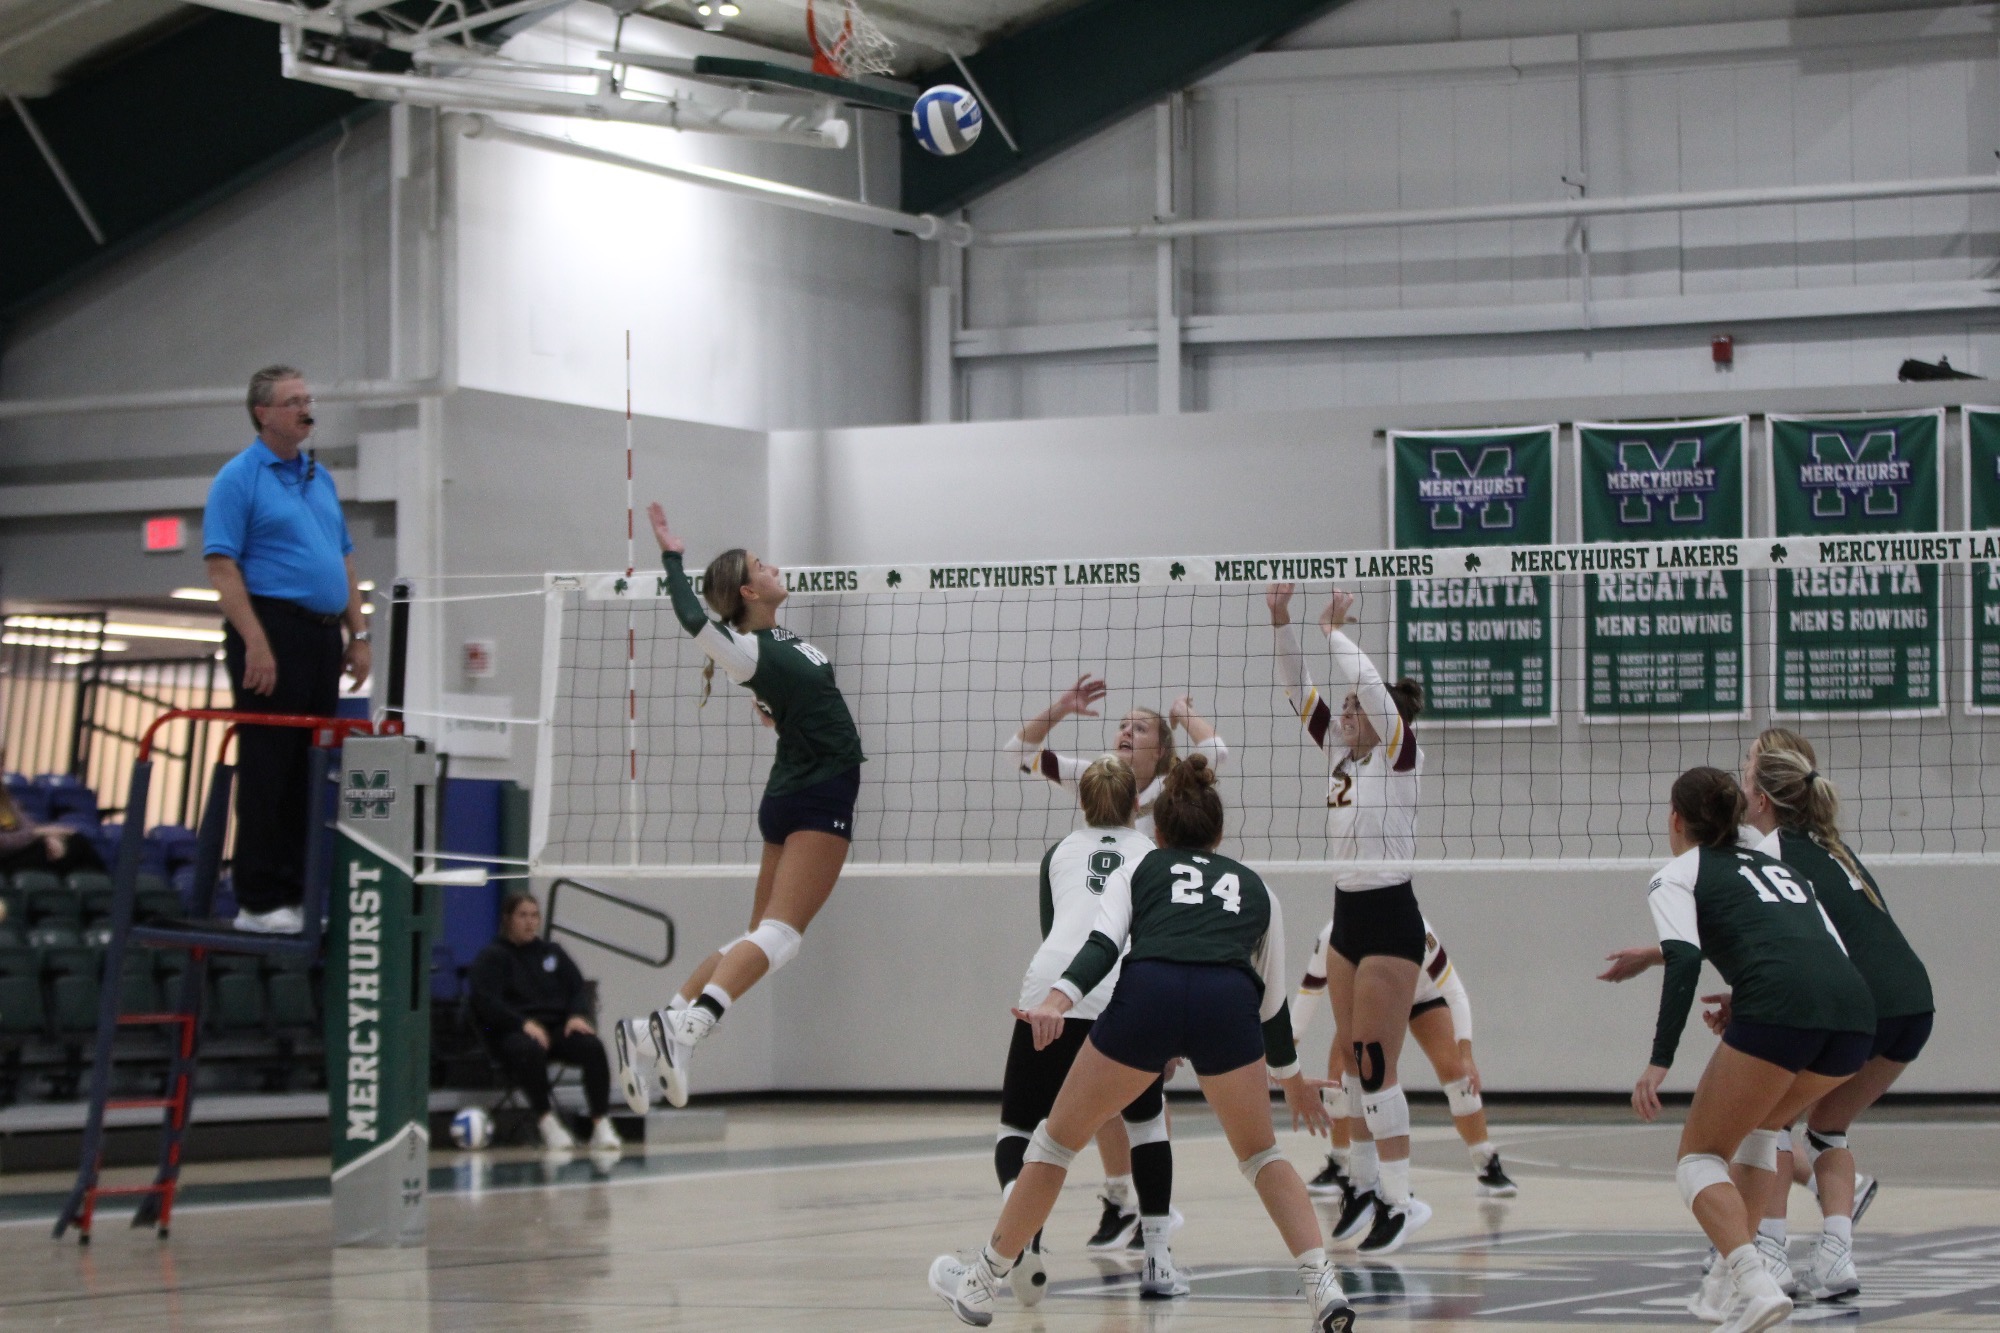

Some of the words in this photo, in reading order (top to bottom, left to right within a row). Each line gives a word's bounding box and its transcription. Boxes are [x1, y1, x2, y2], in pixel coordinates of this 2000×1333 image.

[1419, 477, 1525, 497] MERCYHURST
[1607, 469, 1715, 489] MERCYHURST
[1800, 461, 1910, 482] MERCYHURST
[786, 571, 858, 592] LAKERS
[929, 565, 1057, 588] MERCYHURST
[1064, 563, 1140, 586] LAKERS
[1215, 556, 1347, 581] MERCYHURST
[1355, 554, 1434, 577] LAKERS
[1511, 548, 1650, 572] MERCYHURST
[1656, 544, 1739, 567] LAKERS
[1819, 538, 1961, 563] MERCYHURST
[1969, 536, 2000, 559] LA
[1410, 576, 1538, 608] REGATTA
[1597, 570, 1728, 602] REGATTA
[1791, 564, 1921, 597] REGATTA
[1467, 618, 1542, 641] ROWING
[1656, 613, 1732, 635] ROWING
[1850, 608, 1928, 631] ROWING
[1086, 850, 1124, 895] 9
[1738, 865, 1808, 904] 16
[1170, 863, 1241, 915] 24
[347, 860, 382, 1142] MERCYHURST
